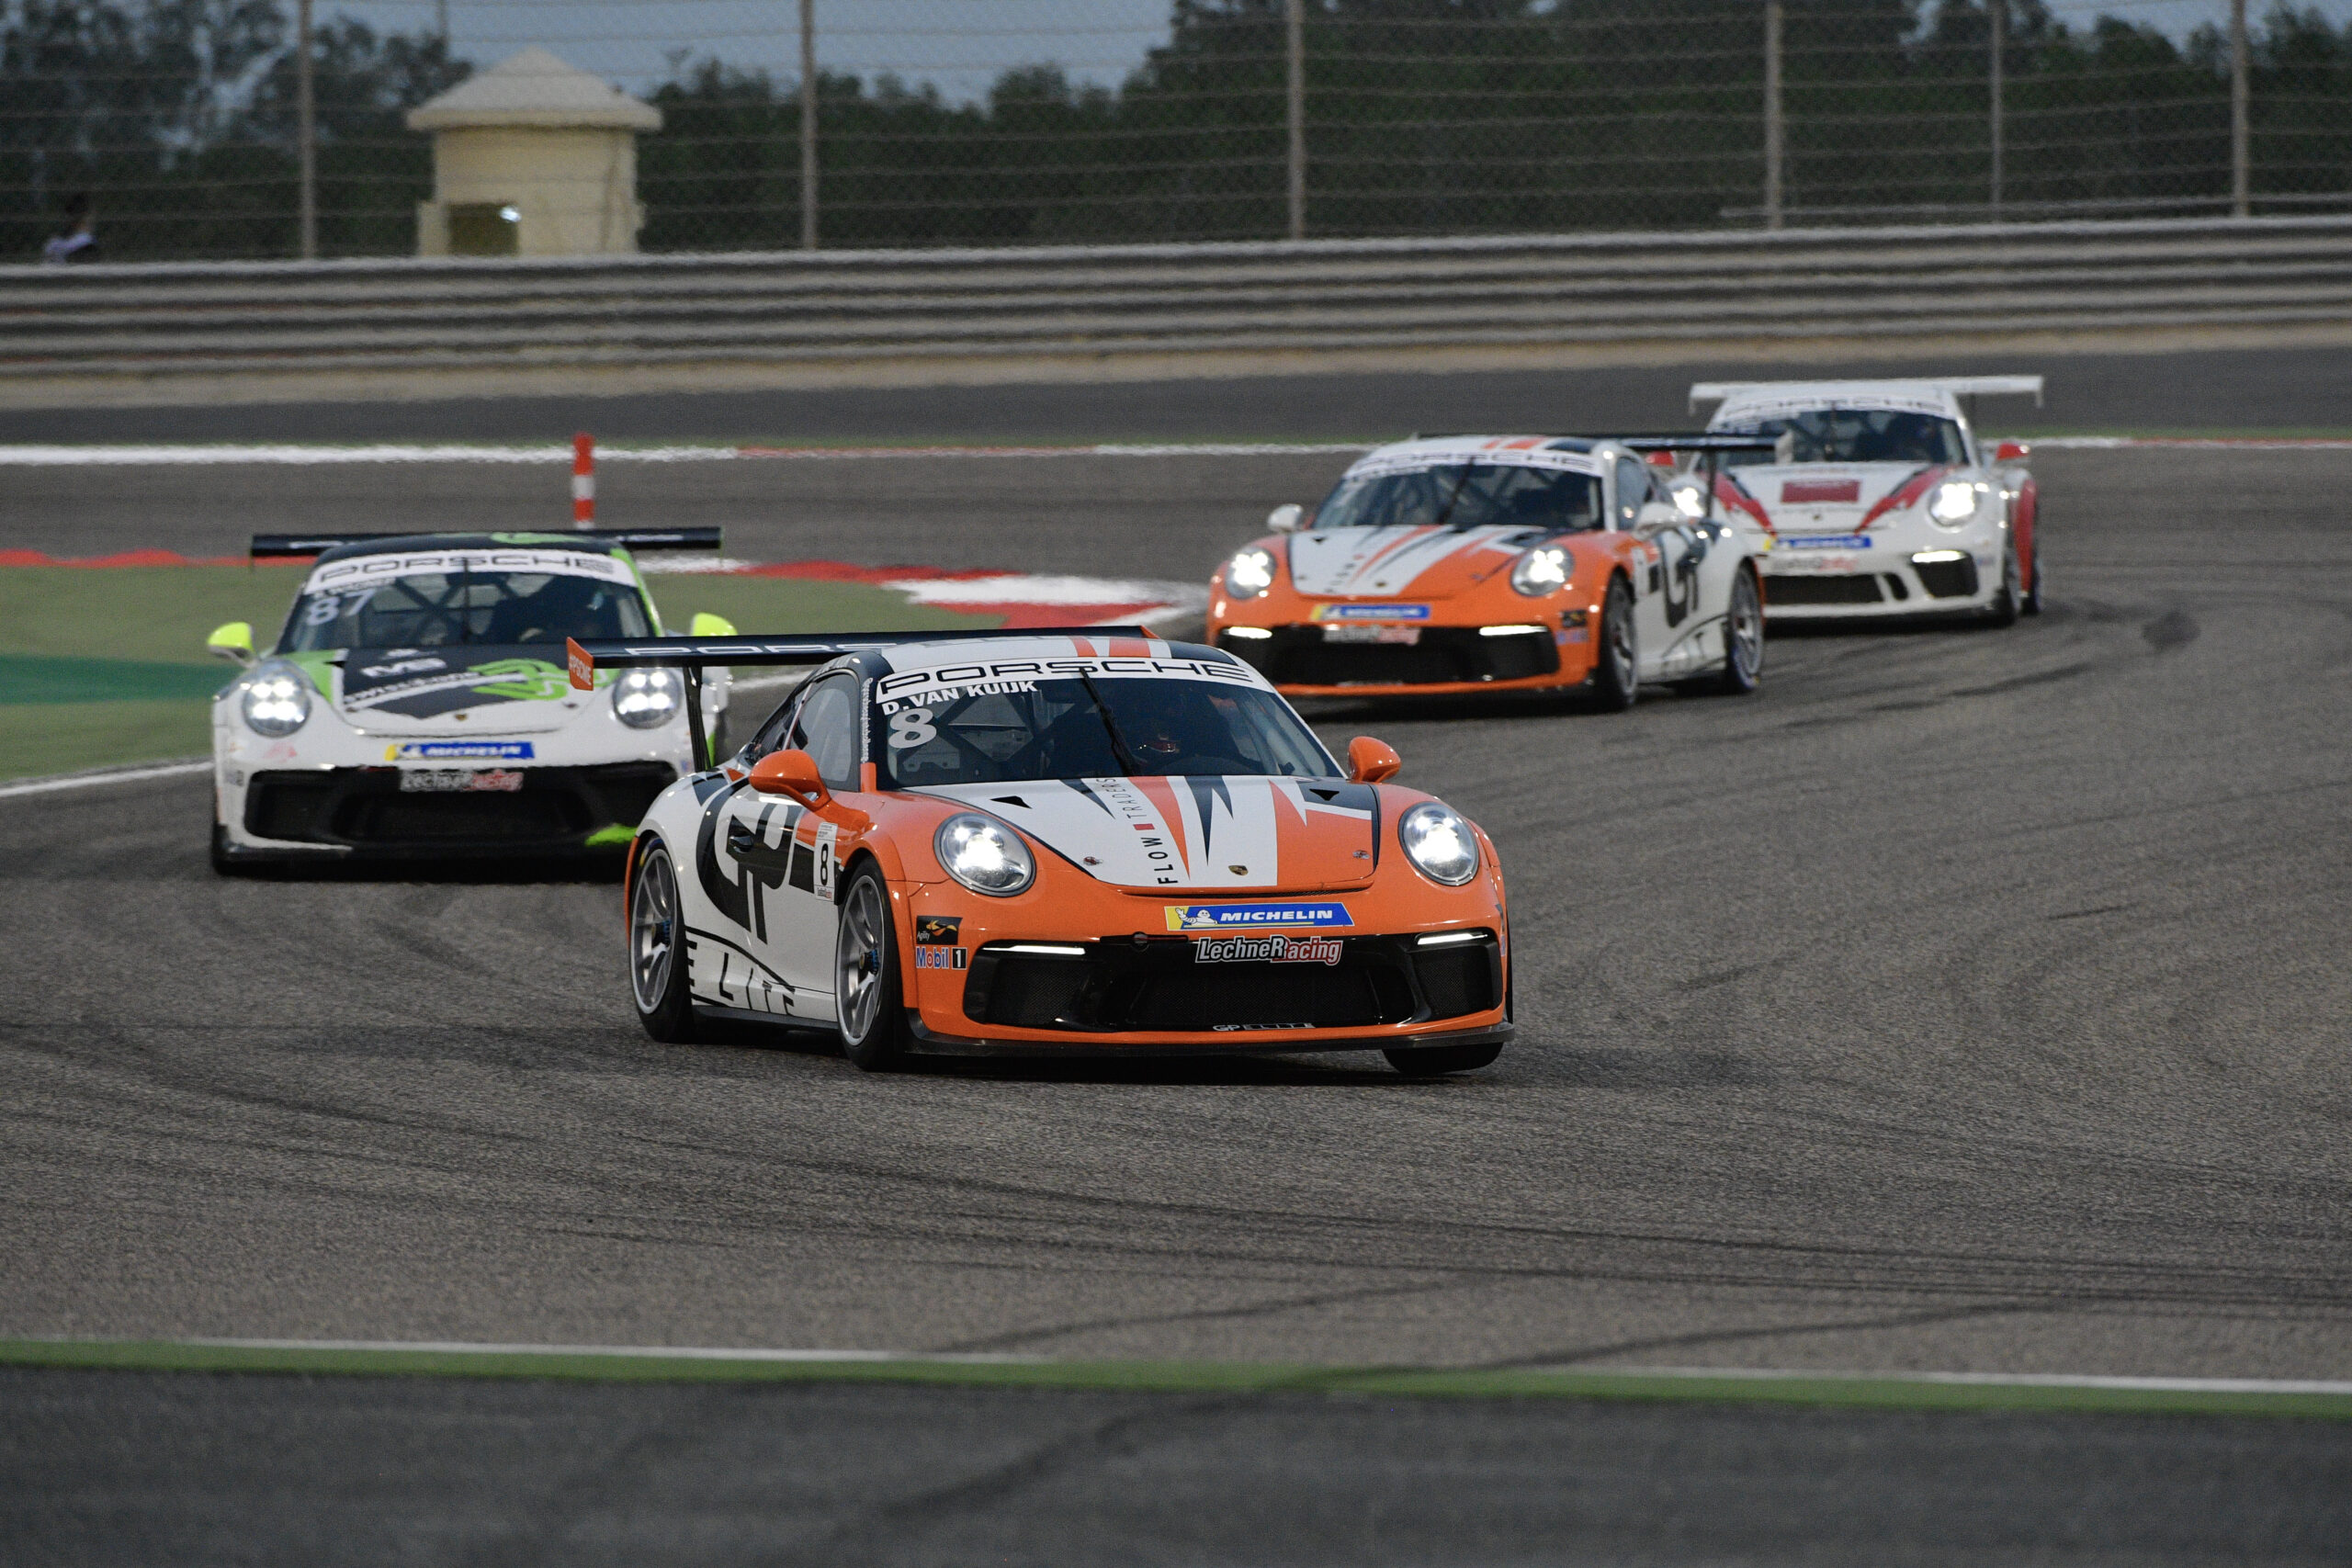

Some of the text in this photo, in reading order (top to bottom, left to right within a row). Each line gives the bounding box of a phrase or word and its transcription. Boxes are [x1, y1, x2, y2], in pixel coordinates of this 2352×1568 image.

[321, 556, 614, 583] PORSCHE
[306, 589, 377, 626] 87
[879, 660, 1255, 694] PORSCHE
[888, 707, 937, 749] 8
[820, 843, 829, 886] 8
[1140, 837, 1179, 885] FLOW
[1219, 909, 1333, 922] MICHELIN
[916, 946, 949, 969] Mobil
